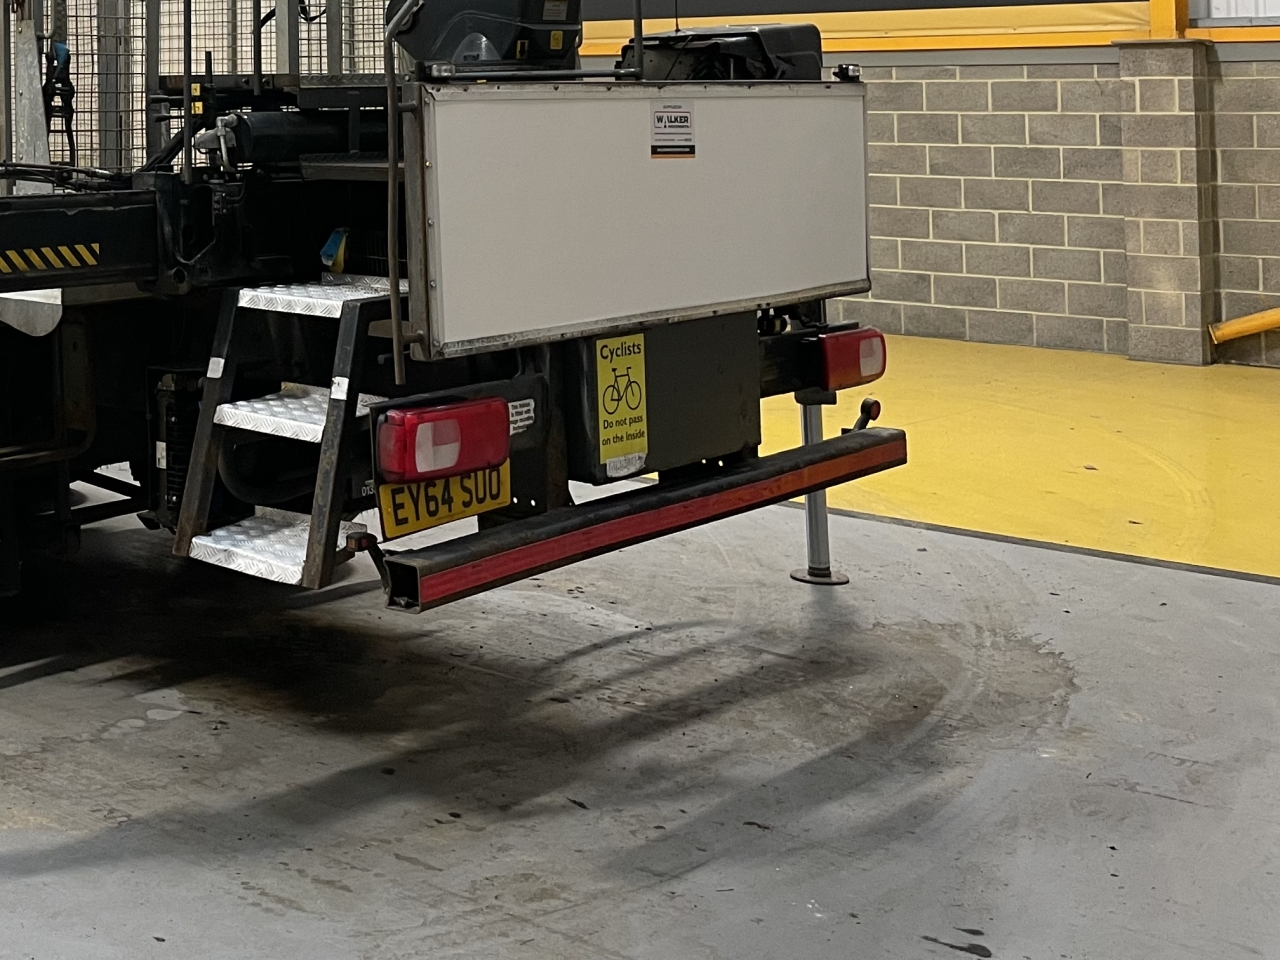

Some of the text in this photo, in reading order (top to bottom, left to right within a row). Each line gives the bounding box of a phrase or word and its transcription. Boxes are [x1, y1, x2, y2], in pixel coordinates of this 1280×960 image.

[600, 342, 642, 363] Cyclists
[603, 415, 643, 430] Do not pass
[602, 437, 611, 446] on
[612, 433, 624, 443] the
[390, 479, 454, 527] EY64
